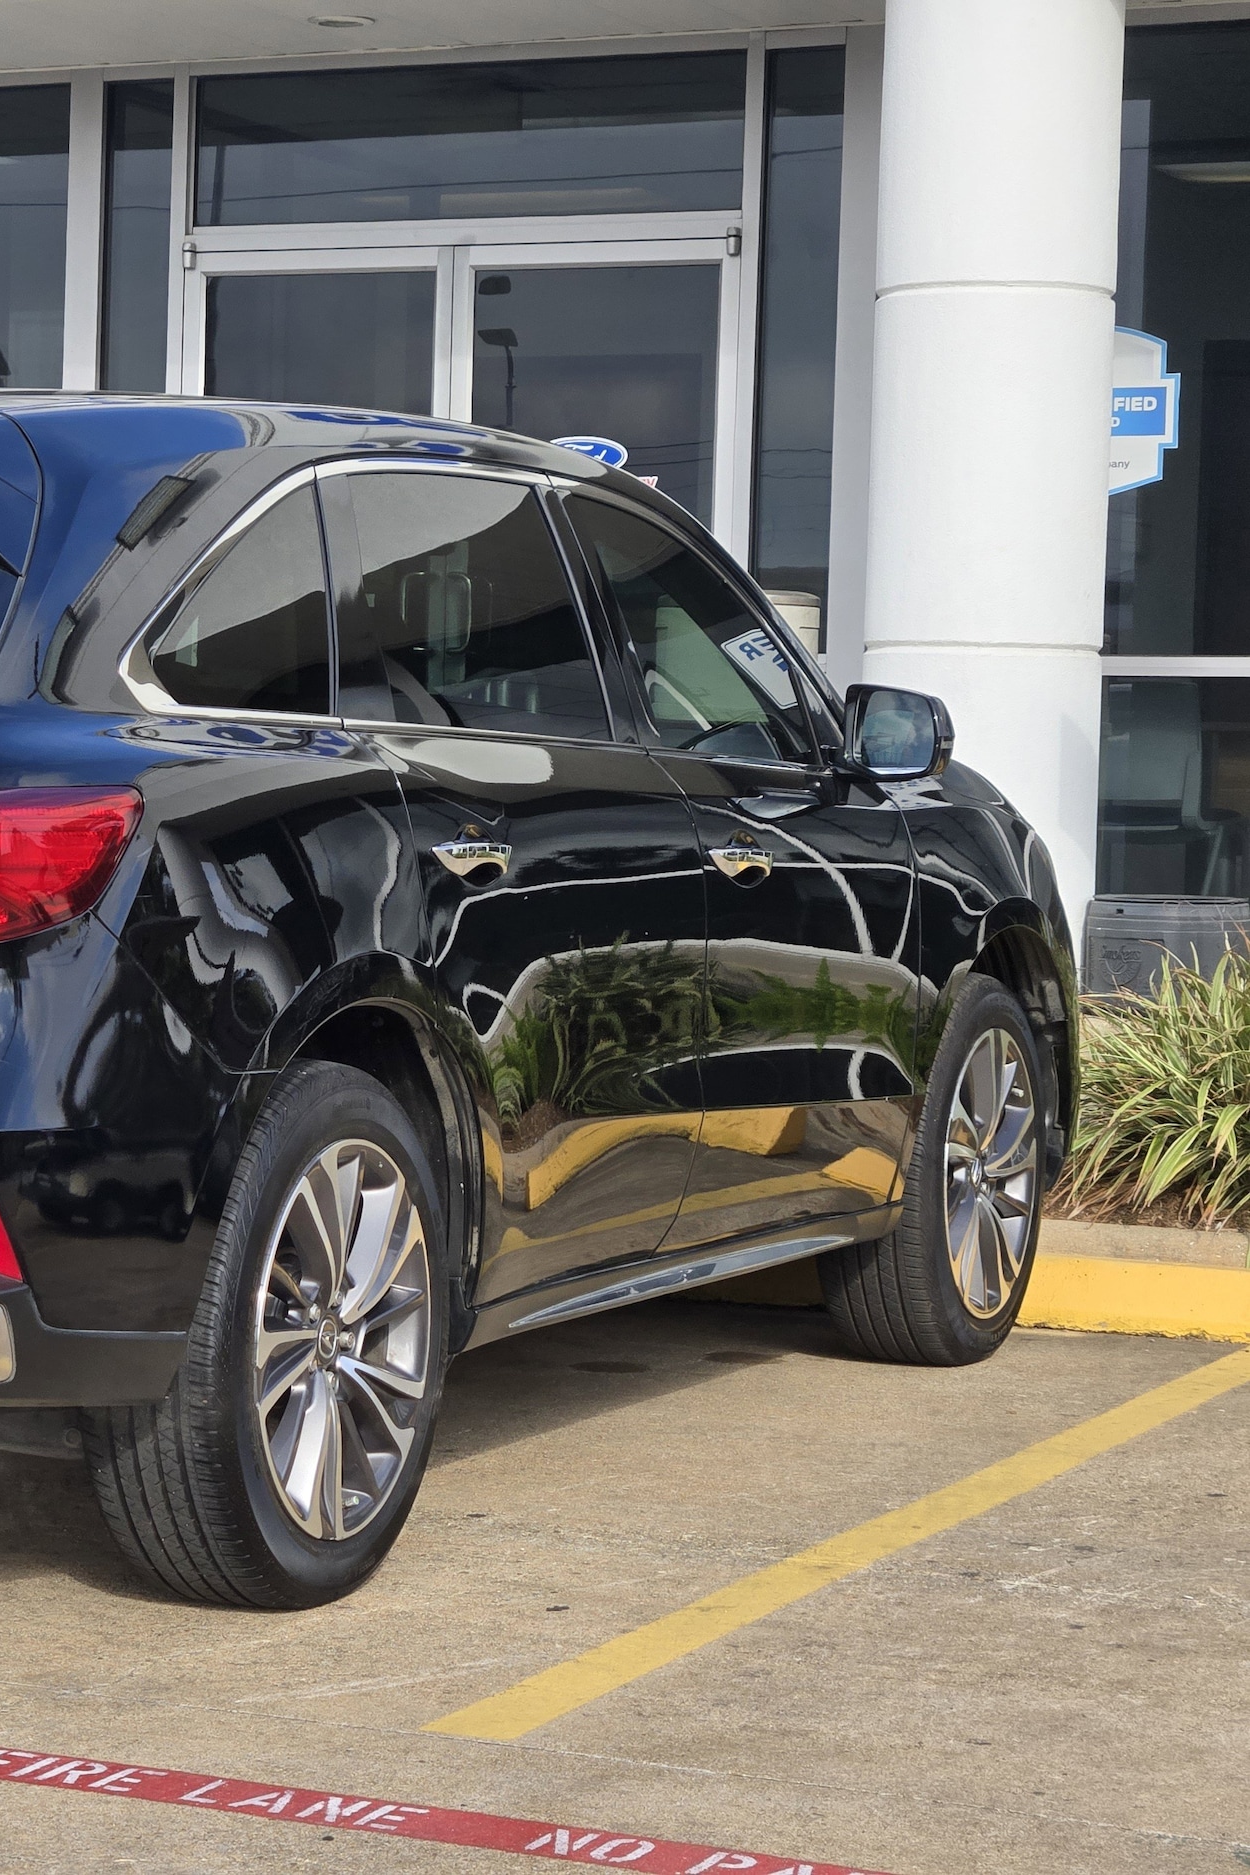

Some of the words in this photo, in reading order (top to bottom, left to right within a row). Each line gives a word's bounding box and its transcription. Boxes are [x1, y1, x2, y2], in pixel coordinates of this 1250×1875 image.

[1108, 460, 1131, 470] any
[178, 1778, 430, 1831] LANE
[524, 1828, 656, 1864] NO
